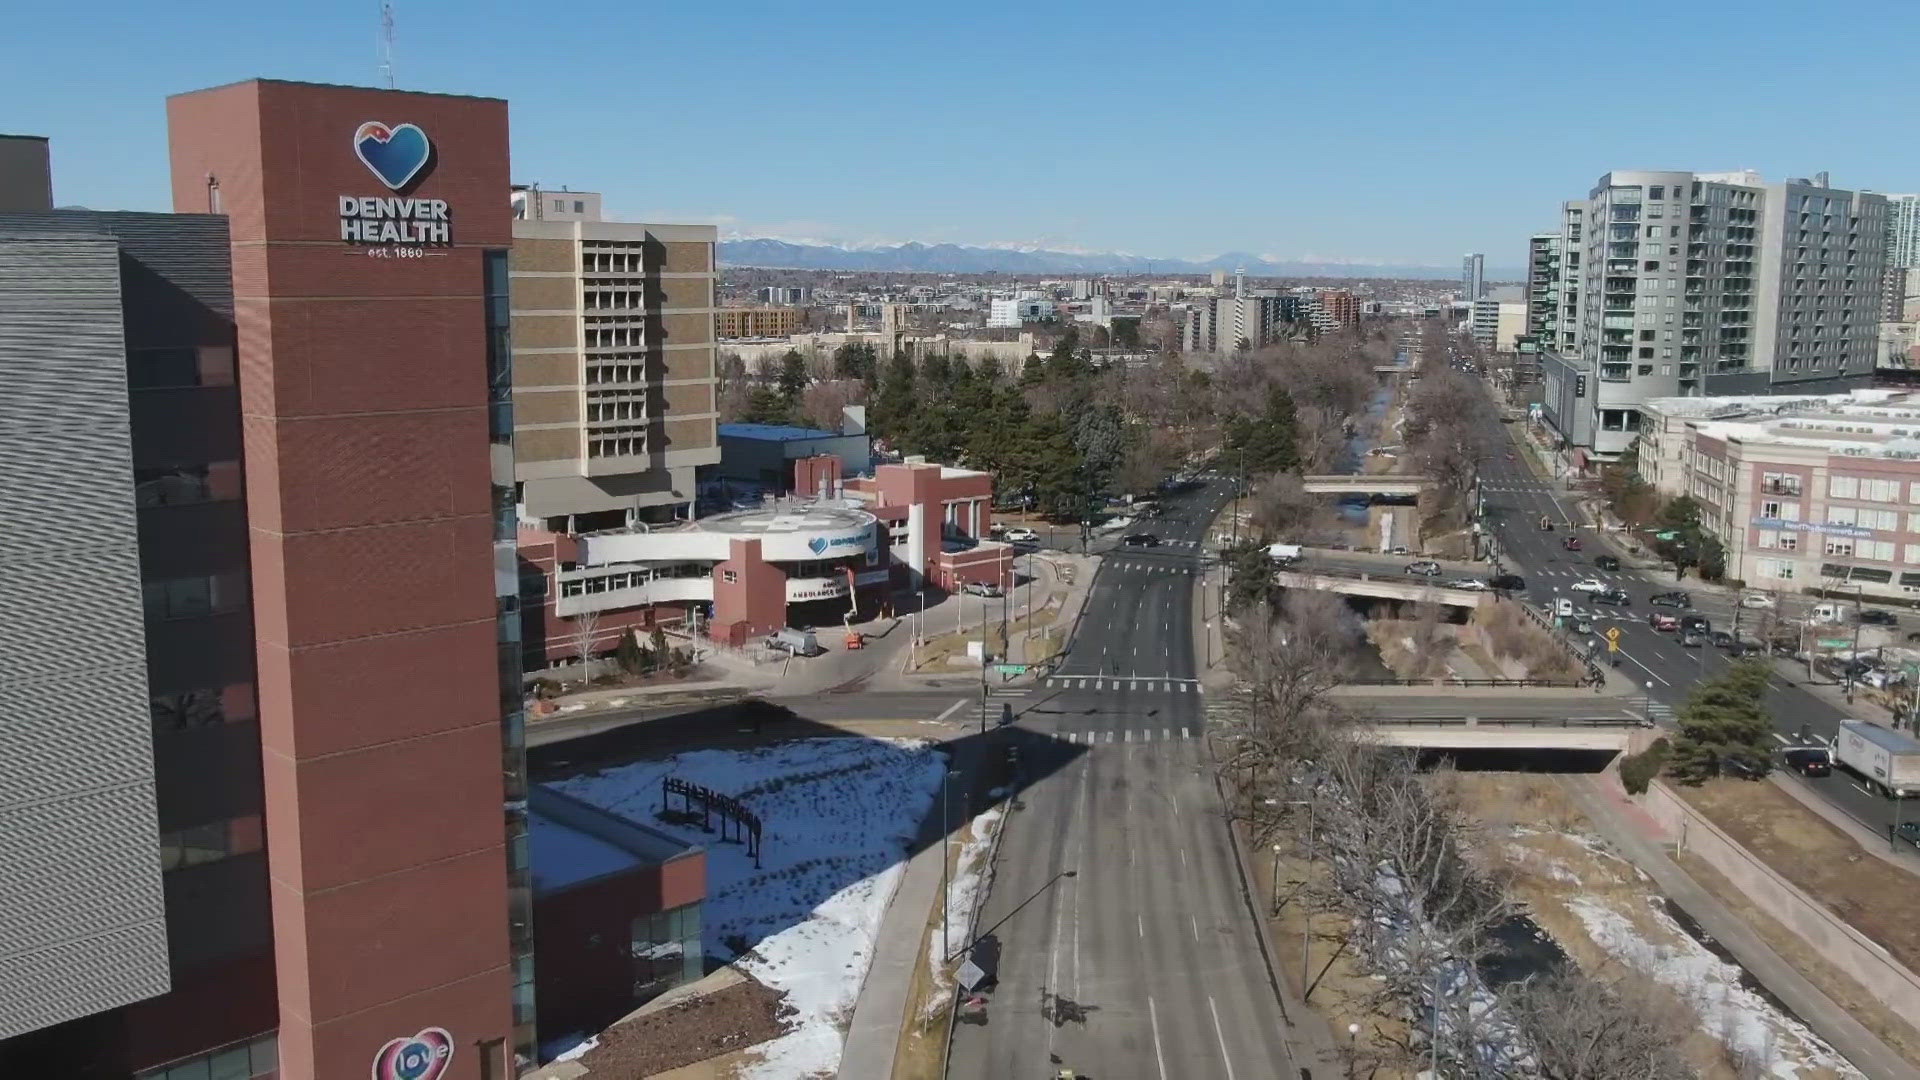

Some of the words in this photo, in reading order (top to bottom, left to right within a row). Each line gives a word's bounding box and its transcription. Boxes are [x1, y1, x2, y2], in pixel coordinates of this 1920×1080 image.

[340, 196, 449, 220] DENVER
[341, 219, 450, 242] HEALTH
[368, 248, 392, 258] est.
[395, 248, 423, 258] 1860
